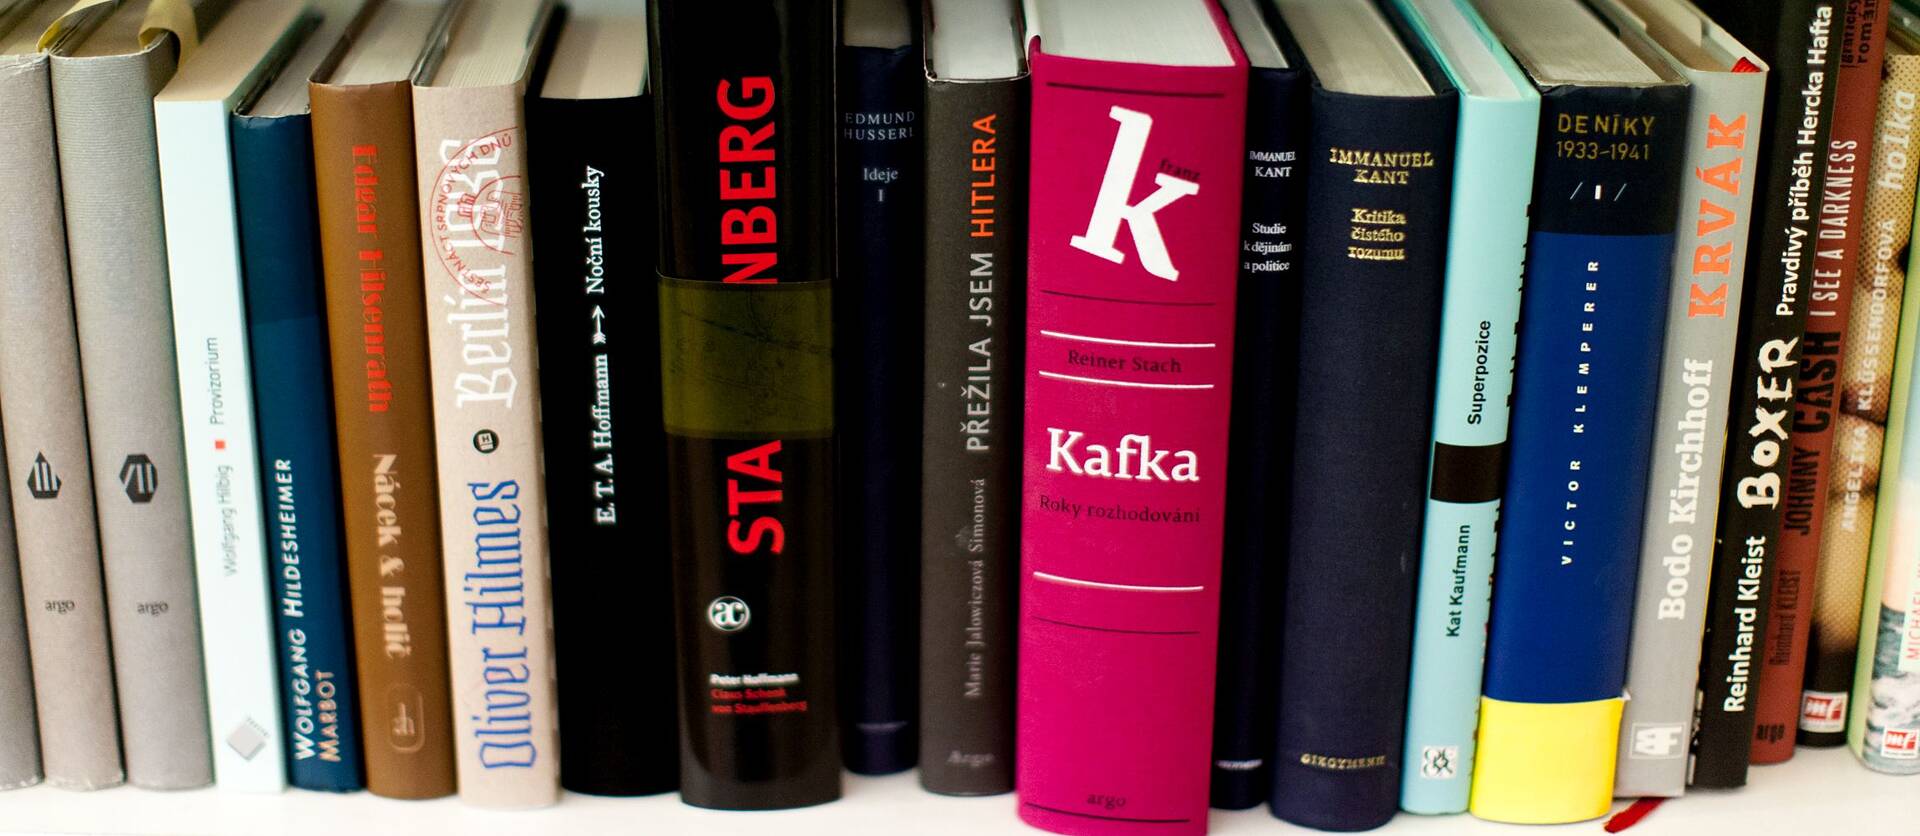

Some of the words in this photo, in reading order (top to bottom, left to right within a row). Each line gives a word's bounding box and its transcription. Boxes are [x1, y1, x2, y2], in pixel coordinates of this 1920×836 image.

[1807, 6, 1833, 64] Hafta
[843, 127, 914, 140] HUSSERL
[845, 111, 915, 125] EDMUND
[1557, 113, 1656, 136] DENÍKY
[1798, 72, 1824, 145] Hercka
[1249, 150, 1296, 163] IMMANUEL
[1329, 147, 1434, 167] IMMANUEL
[1878, 90, 1916, 190] holka
[581, 165, 605, 232] kousky
[863, 167, 898, 183] Ideje
[970, 114, 996, 238] HITLERA
[1069, 105, 1200, 282] k
[1254, 166, 1292, 178] KANT
[1353, 169, 1409, 185] KANT
[1788, 152, 1813, 220] příběh
[1820, 140, 1857, 239] DARKNESS
[1252, 222, 1287, 235] Studie
[1351, 207, 1406, 225] Kritika
[1351, 227, 1405, 242] čistého
[1688, 112, 1748, 319] KRVÁK
[586, 237, 605, 294] Noční
[1251, 241, 1292, 256] dějinám
[1252, 260, 1290, 273] politice
[1348, 246, 1405, 260] rozumu
[1776, 226, 1808, 316] Pravdivý
[1817, 249, 1845, 259] A
[968, 252, 993, 326] JSEM
[1812, 269, 1841, 301] SEE
[444, 264, 518, 409] Berlín
[1068, 349, 1126, 370] Reiner
[1132, 356, 1182, 373] Stach
[206, 337, 224, 425] Provizorium
[592, 353, 612, 449] Hoffmann
[960, 337, 992, 451] PŘEŽILA
[1467, 320, 1491, 425] Superpozice
[1792, 331, 1841, 433] CASH
[1561, 460, 1581, 565] VICTOR
[1573, 261, 1600, 433] KLEMPERER
[1668, 358, 1714, 524] Kirchhoff
[217, 464, 233, 505] Hilbig
[593, 453, 614, 474] A.
[1046, 427, 1200, 482] Kafka
[373, 454, 401, 547] Nácek
[595, 478, 615, 498] T.
[596, 502, 617, 524] E.
[968, 478, 986, 553] Simonová
[1039, 494, 1082, 518] Roky
[1087, 504, 1200, 523] rozhodování
[1784, 447, 1820, 536] JOHNNY
[223, 507, 240, 577] Wolfgang
[275, 458, 304, 619] HILDESHEIMER
[379, 554, 405, 577] &
[463, 479, 527, 636] Hilmes
[1449, 523, 1471, 602] Kaufmann
[1737, 536, 1766, 601] Kleist
[966, 559, 985, 646] Jalowiczová
[1658, 533, 1694, 620] Bodo
[45, 600, 75, 615] argo
[137, 601, 168, 616] argo
[1446, 605, 1463, 637] Kat
[710, 674, 741, 686] Peter
[742, 673, 799, 686] Hoffmann
[964, 652, 982, 698] Marie
[1724, 607, 1756, 712] Reinhard
[287, 628, 316, 760] WOLFGANG
[315, 669, 341, 762] MARBOT
[472, 646, 537, 769] Oliver
[1087, 794, 1126, 810] argo
